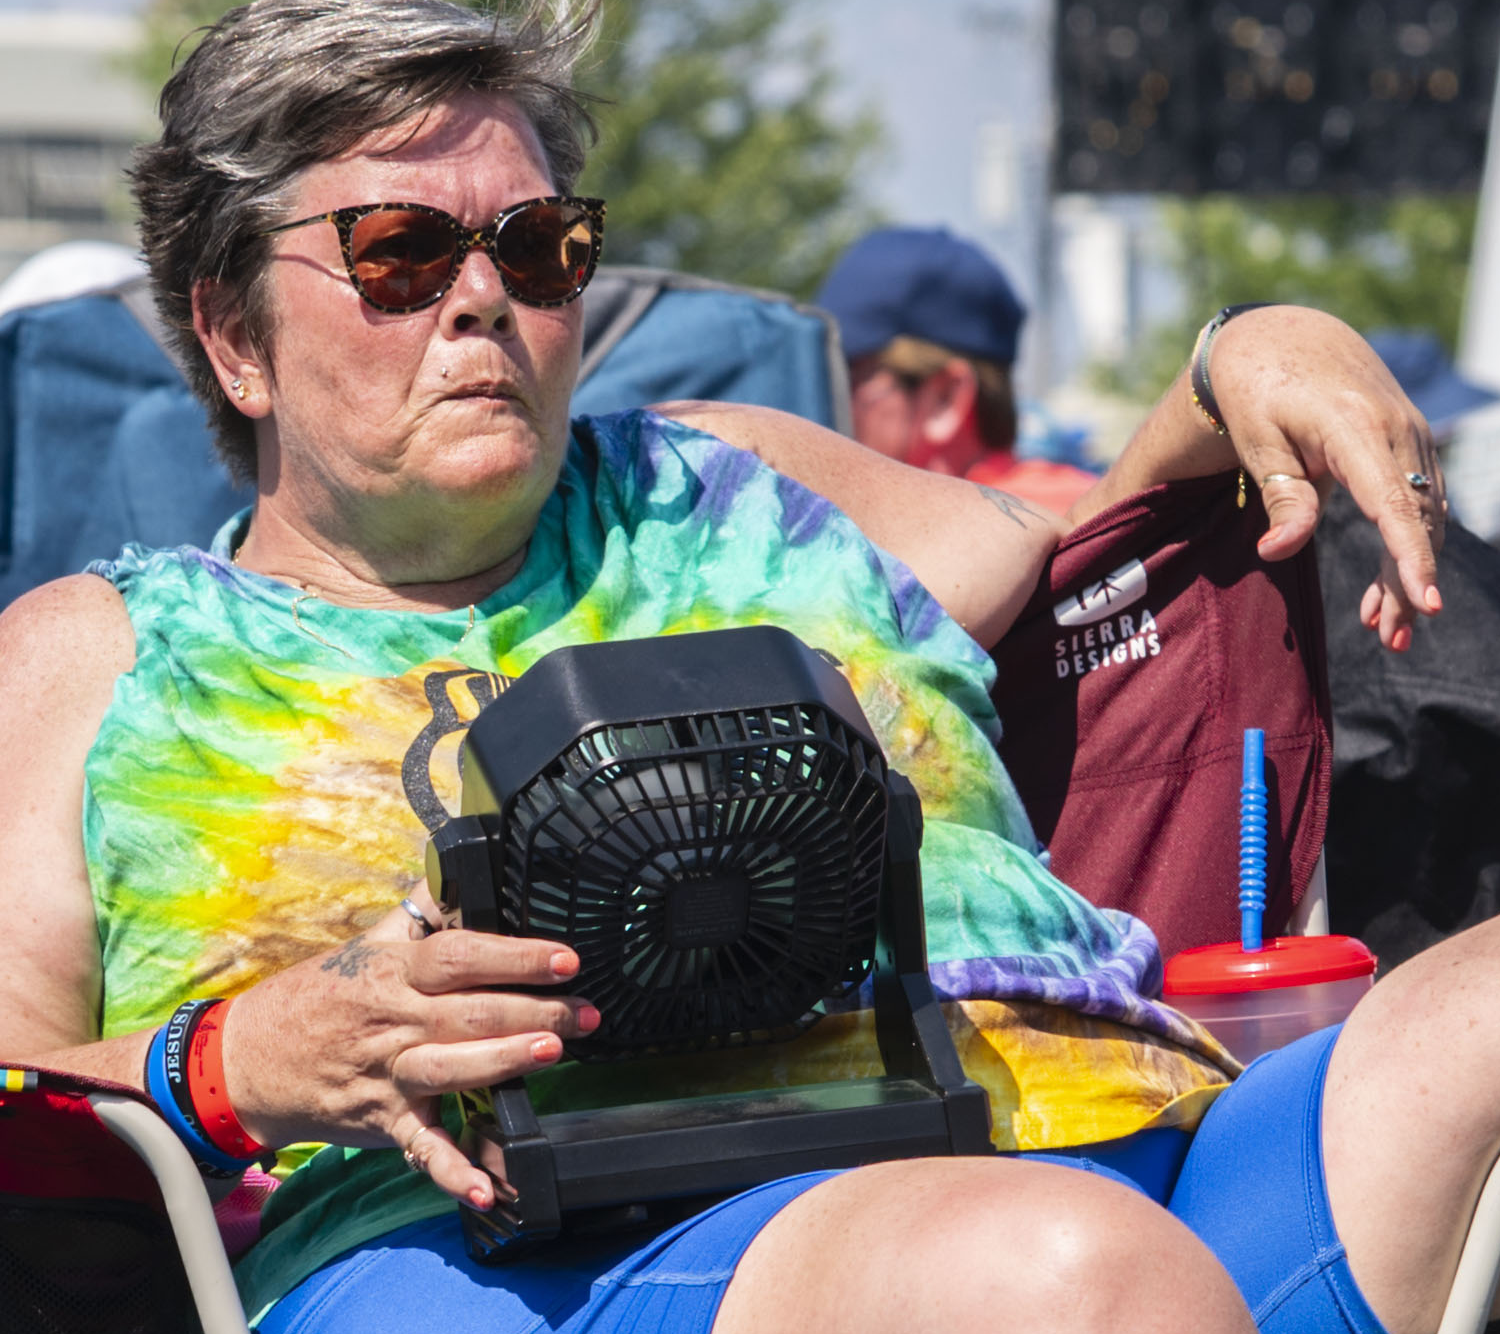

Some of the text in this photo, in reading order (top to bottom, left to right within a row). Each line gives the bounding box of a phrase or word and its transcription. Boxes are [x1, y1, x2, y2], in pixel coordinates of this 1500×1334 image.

[1055, 608, 1157, 657] SIERRA
[1055, 634, 1161, 678] DESIGNS
[166, 1012, 189, 1084] JESUS
